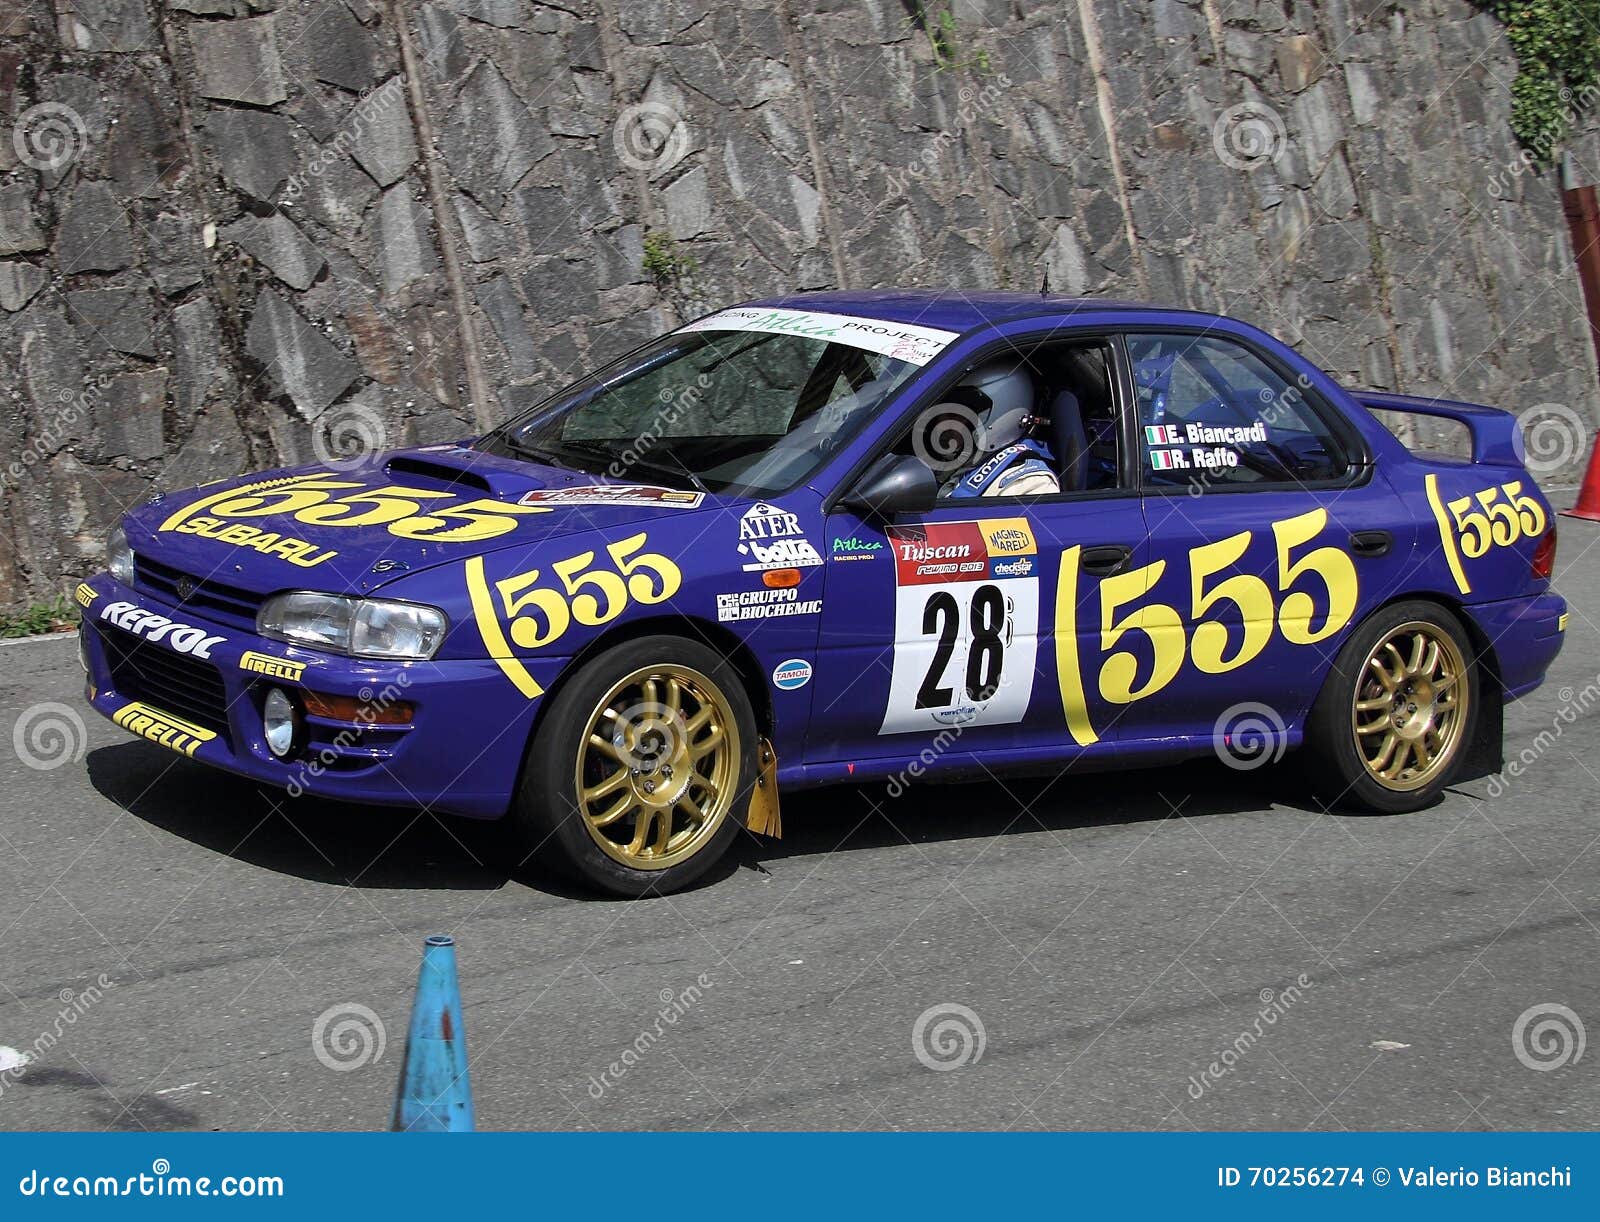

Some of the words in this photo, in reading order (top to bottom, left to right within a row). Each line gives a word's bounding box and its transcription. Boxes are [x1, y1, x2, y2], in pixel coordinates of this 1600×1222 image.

[842, 322, 947, 347] PROJECT
[1165, 424, 1184, 444] E.
[1186, 422, 1267, 444] Biancardi
[1171, 449, 1190, 469] R.
[1192, 447, 1238, 469] Raffo
[210, 481, 554, 542] 555
[1447, 480, 1546, 559] 555
[739, 513, 803, 540] ATER
[175, 516, 338, 568] SUBARU
[900, 544, 971, 561] Tuscan
[960, 562, 984, 572] 2013
[495, 532, 683, 649] 555
[740, 588, 798, 606] GRUPPO
[740, 600, 823, 620] BIOCHEMIC
[1099, 507, 1359, 704] 555
[100, 602, 228, 660] REPSOL
[915, 584, 1005, 710] 28
[239, 650, 308, 682] PIRELLI
[776, 669, 809, 680] TAMOIL
[112, 701, 217, 758] PIRELLI
